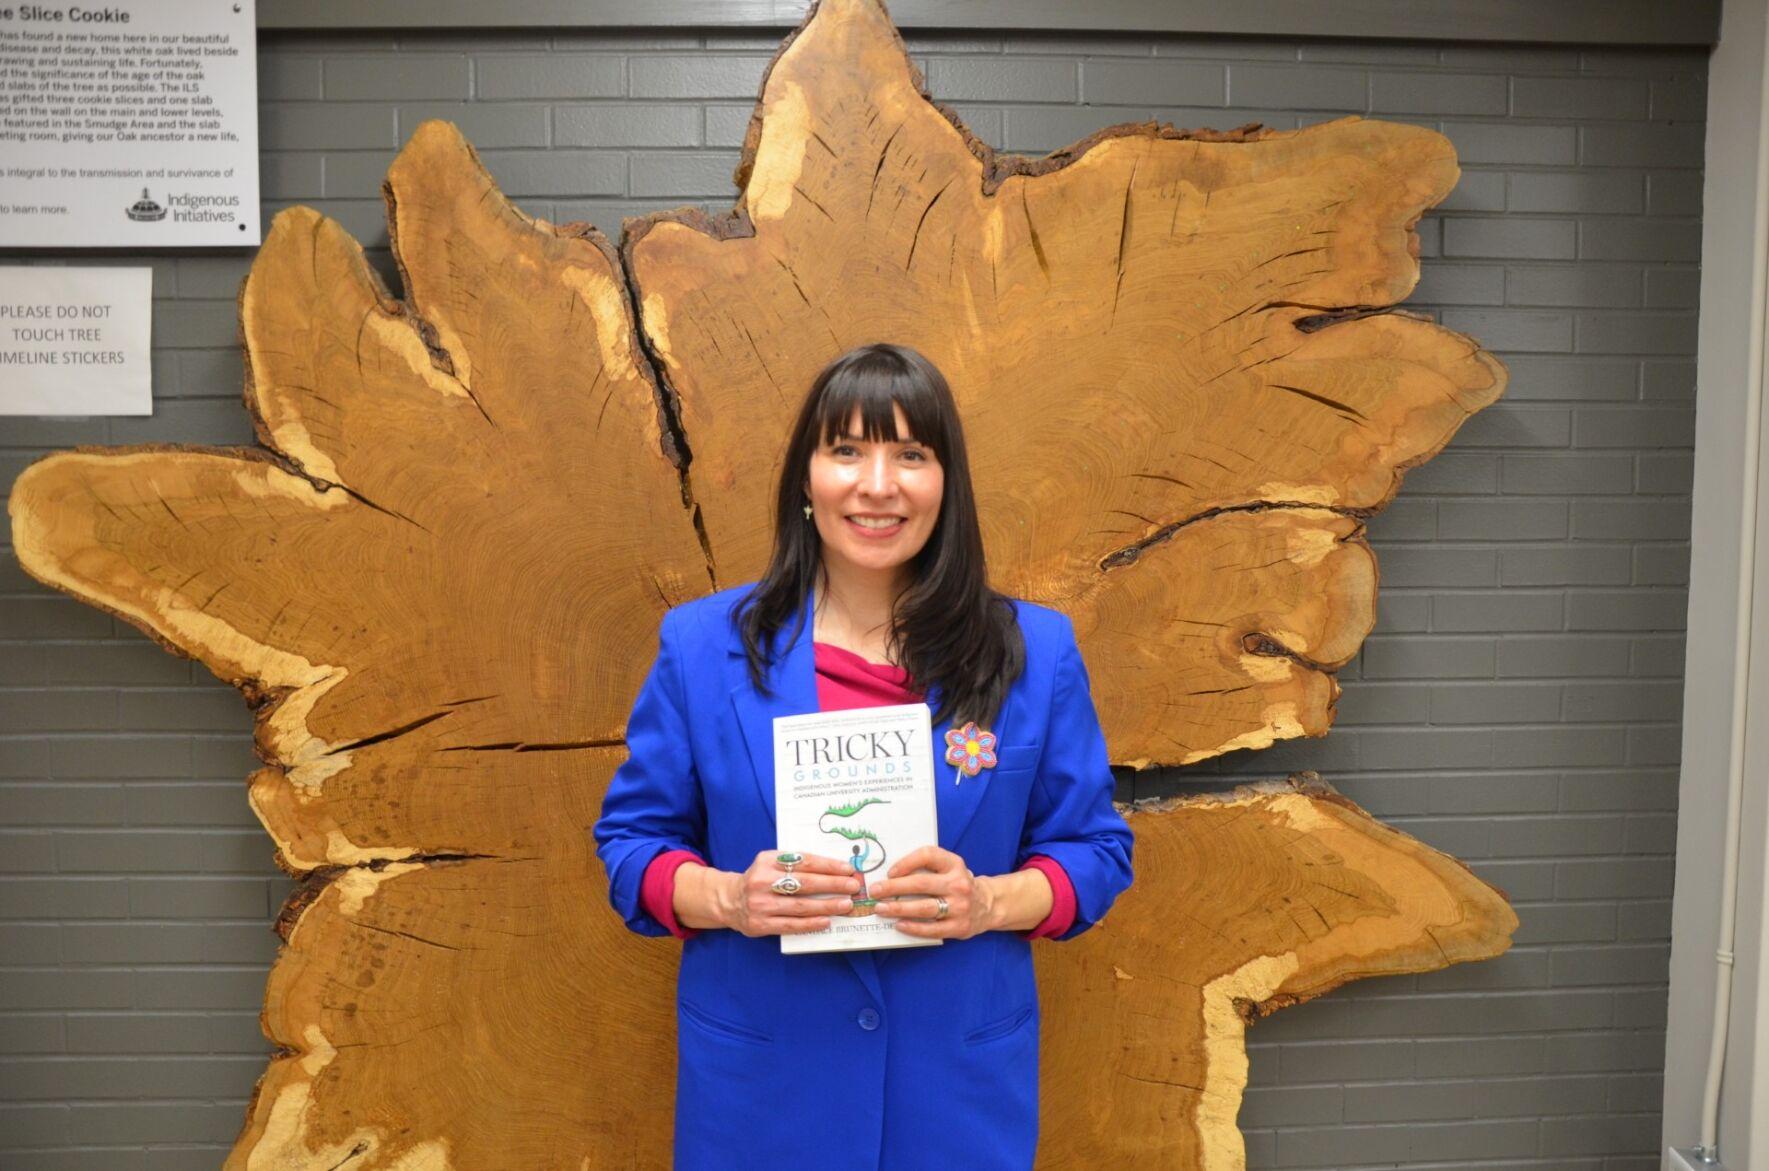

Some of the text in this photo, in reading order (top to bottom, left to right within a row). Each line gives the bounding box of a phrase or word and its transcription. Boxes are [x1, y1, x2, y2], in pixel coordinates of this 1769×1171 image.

[0, 5, 130, 24] e Slice Cookie
[22, 30, 54, 41] found
[65, 34, 88, 42] new
[90, 33, 120, 42] home
[123, 33, 147, 43] here
[149, 34, 160, 43] in
[161, 36, 180, 44] our
[182, 34, 229, 44] beautiful
[41, 45, 62, 54] and
[101, 45, 121, 55] this
[123, 46, 153, 56] white
[155, 47, 173, 56] oak
[177, 47, 201, 56] lived
[204, 47, 239, 57] beside
[38, 58, 59, 66] and
[61, 58, 117, 69] sustaining
[10, 69, 28, 78] the
[31, 69, 96, 81] significance
[98, 69, 109, 79] of
[111, 70, 129, 79] the
[131, 72, 151, 81] age
[152, 71, 163, 80] of
[166, 71, 184, 80] the
[186, 71, 205, 80] oak
[8, 81, 36, 91] slabs
[39, 81, 50, 91] of
[52, 82, 70, 91] the
[73, 82, 95, 92] tree
[97, 84, 109, 92] as
[160, 83, 180, 92] The
[12, 93, 44, 105] gifted
[46, 94, 75, 104] three
[77, 94, 112, 104] cookie
[114, 95, 145, 105] slices
[146, 96, 167, 105] and
[169, 97, 189, 105] one
[191, 95, 213, 105] slab
[13, 108, 27, 116] on
[30, 106, 48, 116] the
[50, 106, 71, 116] wall
[73, 109, 88, 117] on
[90, 106, 108, 117] the
[109, 107, 136, 117] main
[138, 107, 158, 117] and
[160, 107, 188, 117] lower
[4, 118, 221, 131] featured in the Smudge Area and the slab
[62, 131, 95, 143] giving
[96, 134, 114, 142] our
[116, 130, 137, 142] Oak
[140, 132, 185, 142] ancestor
[187, 134, 195, 142] a
[197, 133, 218, 142] new
[7, 167, 46, 180] integral
[47, 167, 58, 178] to
[60, 167, 77, 178] the
[79, 167, 143, 178] transmission
[145, 168, 165, 178] and
[167, 167, 221, 178] survivance
[223, 167, 234, 178] of
[168, 193, 240, 210] Indigenous
[12, 203, 39, 215] learn
[173, 209, 236, 223] Initiatives
[0, 305, 112, 319] PLEASE DO NOT
[12, 328, 102, 342] TOUCH TREE
[62, 351, 125, 365] STICKERS
[786, 729, 915, 766] TRICKY
[794, 761, 912, 782] GROUNDS
[793, 784, 914, 800] CANADIAN UNIVERSITY ADMINISTRATION
[836, 922, 896, 934] BRUNETTE-DE
